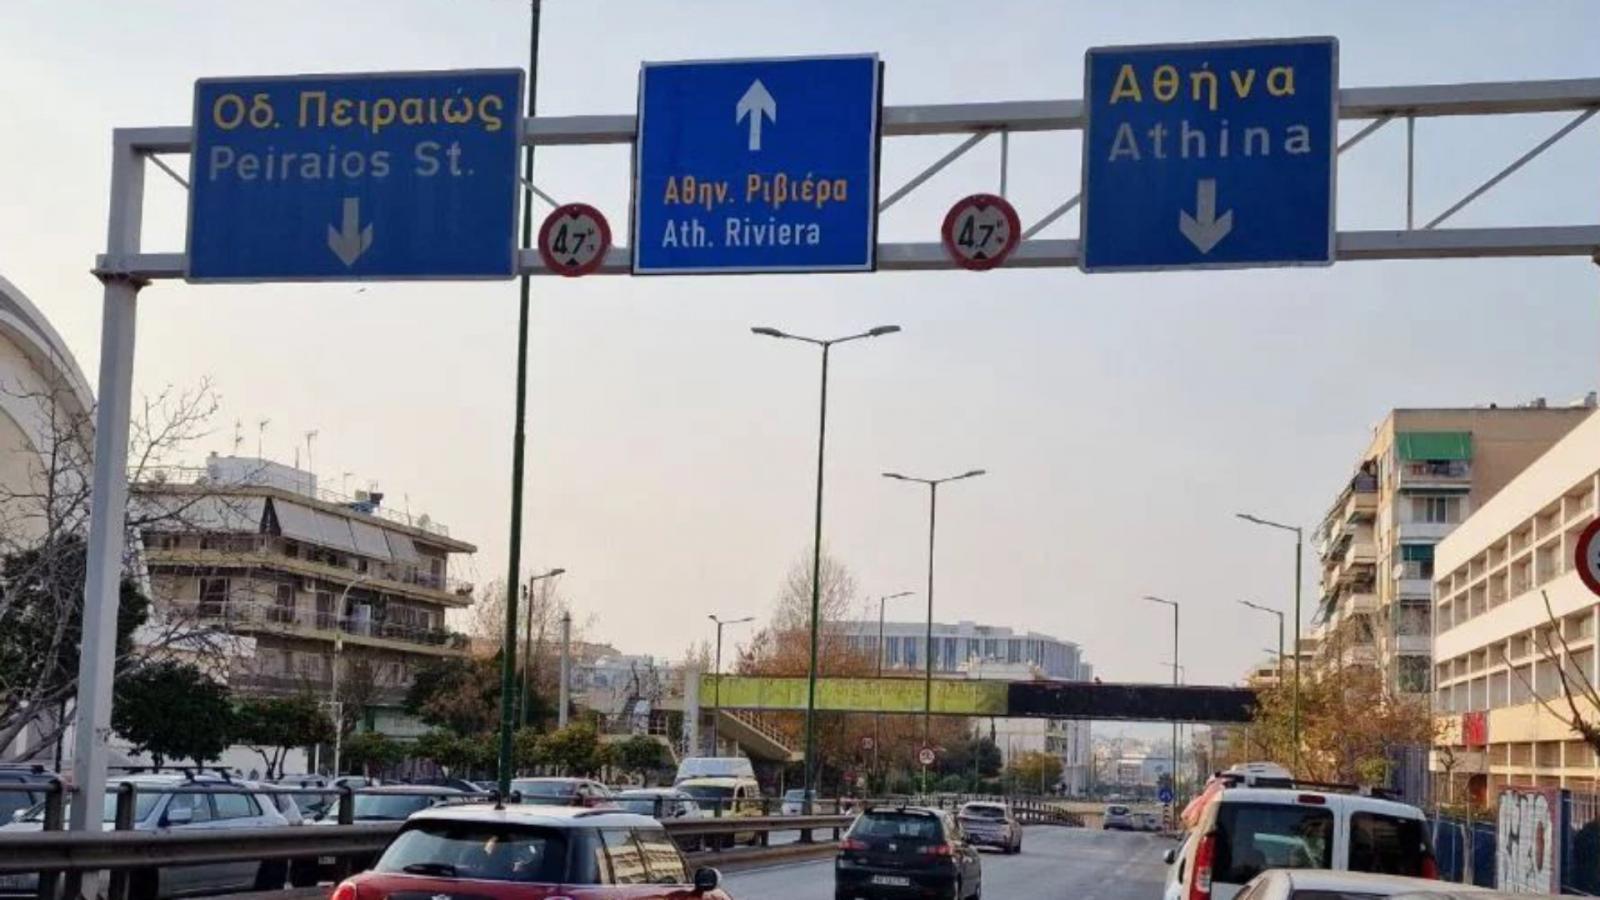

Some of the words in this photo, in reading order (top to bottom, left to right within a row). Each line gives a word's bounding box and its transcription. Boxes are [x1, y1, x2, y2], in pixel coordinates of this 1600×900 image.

[1109, 61, 1296, 111] Αθήνα
[213, 93, 280, 129] Οδ.
[299, 88, 503, 134] Πειραιώς
[209, 145, 390, 181] Peiraios
[413, 140, 475, 177] St.
[1108, 118, 1311, 163] Athina
[664, 175, 734, 211] Αθην.
[747, 172, 847, 209] Ριβιέρα
[661, 218, 714, 248] Ath.
[725, 217, 821, 246] Riviera
